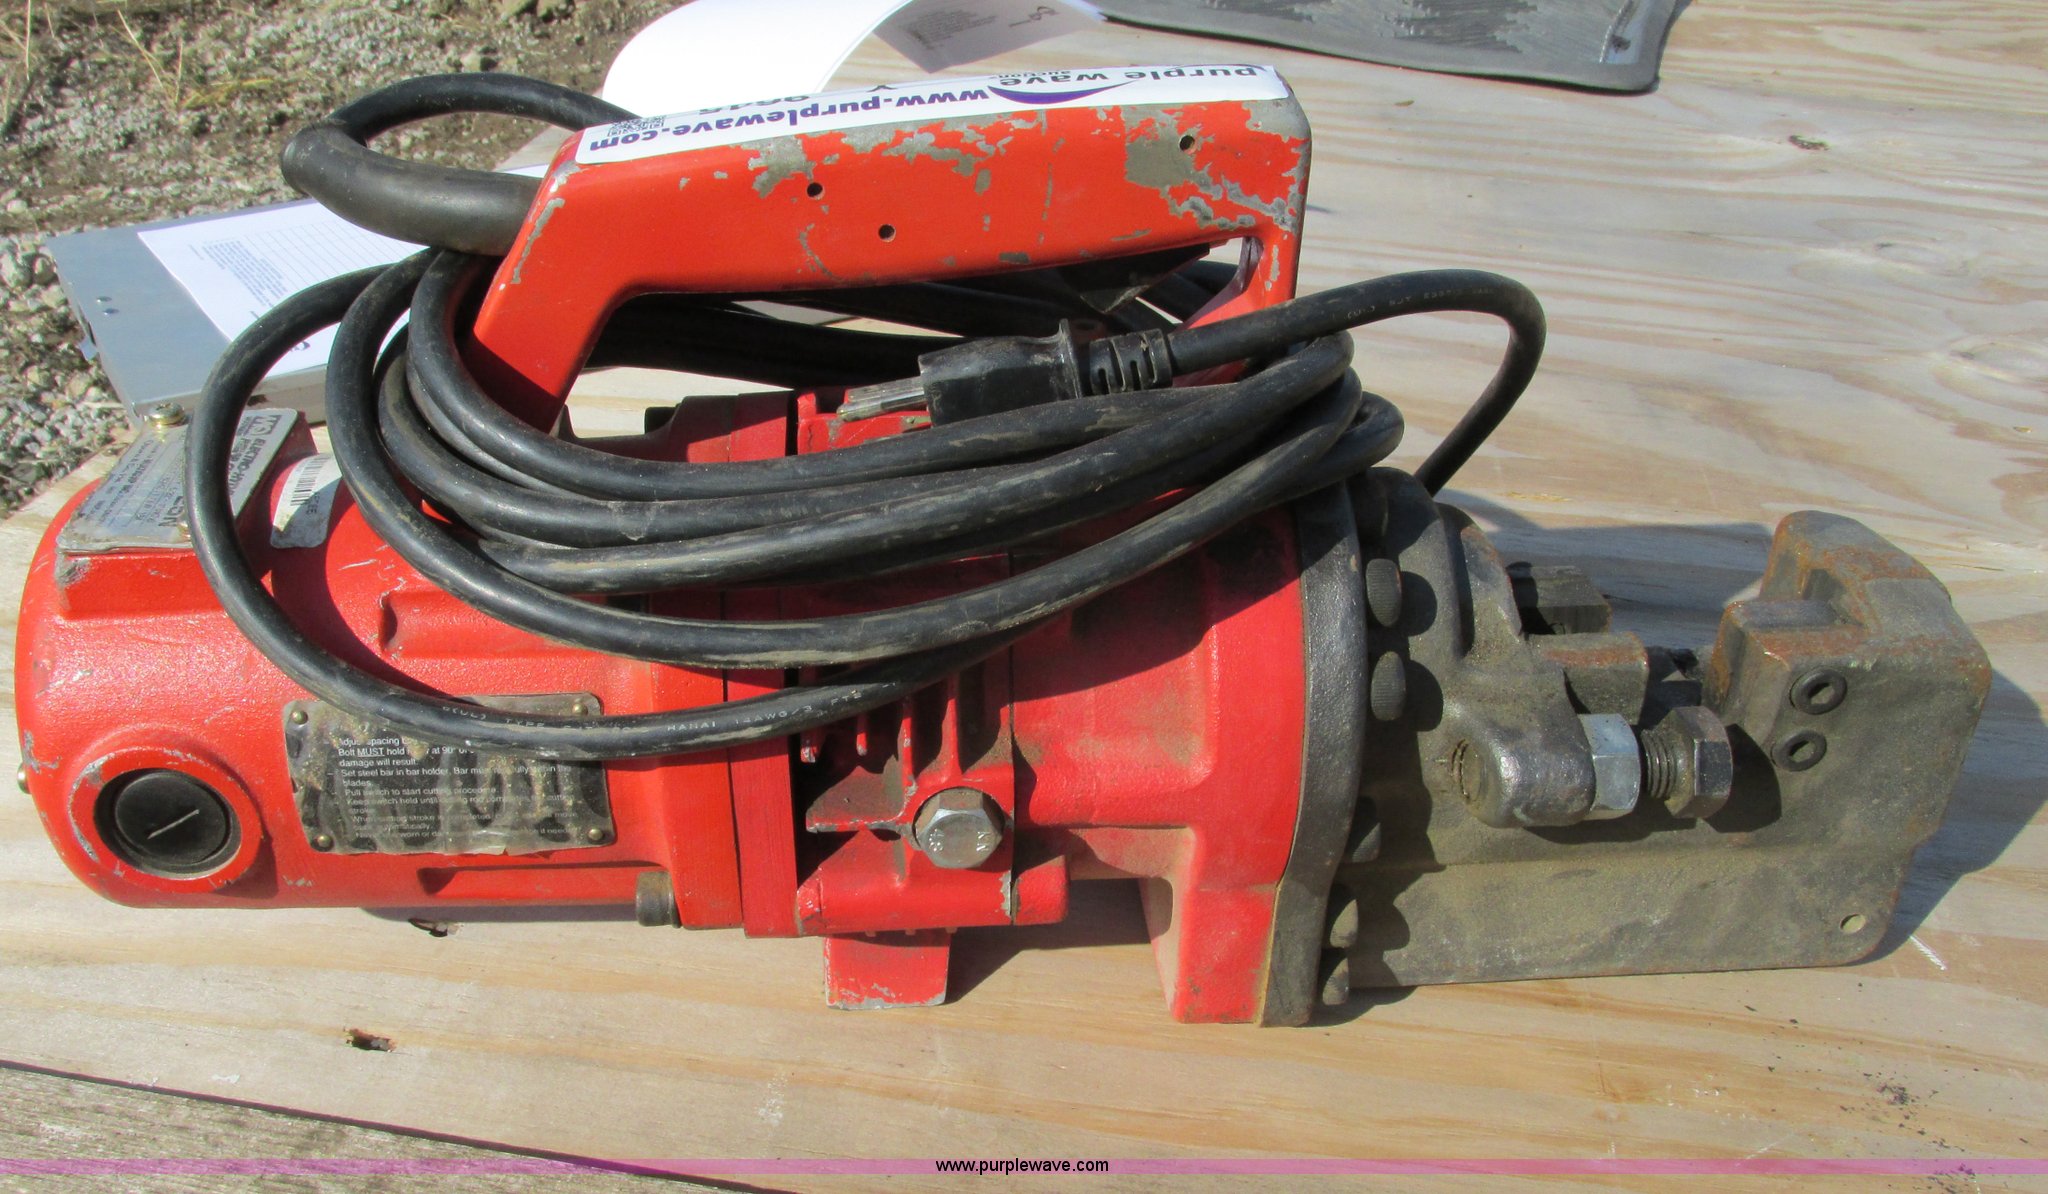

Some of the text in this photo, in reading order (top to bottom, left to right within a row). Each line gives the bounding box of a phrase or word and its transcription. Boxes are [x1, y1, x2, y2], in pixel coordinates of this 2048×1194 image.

[999, 70, 1071, 78] auction
[999, 66, 1257, 86] purple wave
[590, 88, 989, 151] www.purplewave.com
[338, 748, 355, 757] Bolt
[357, 747, 385, 758] MUST
[386, 746, 405, 756] hold
[339, 759, 419, 770] damage will result.
[341, 769, 356, 778] Set
[357, 768, 379, 778] steel
[380, 768, 394, 777] bar
[396, 767, 405, 776] in
[406, 767, 420, 776] bar
[453, 766, 469, 775] Bar
[345, 787, 361, 796] Pull
[391, 786, 401, 795] to
[402, 786, 421, 795] start
[400, 796, 418, 805] held
